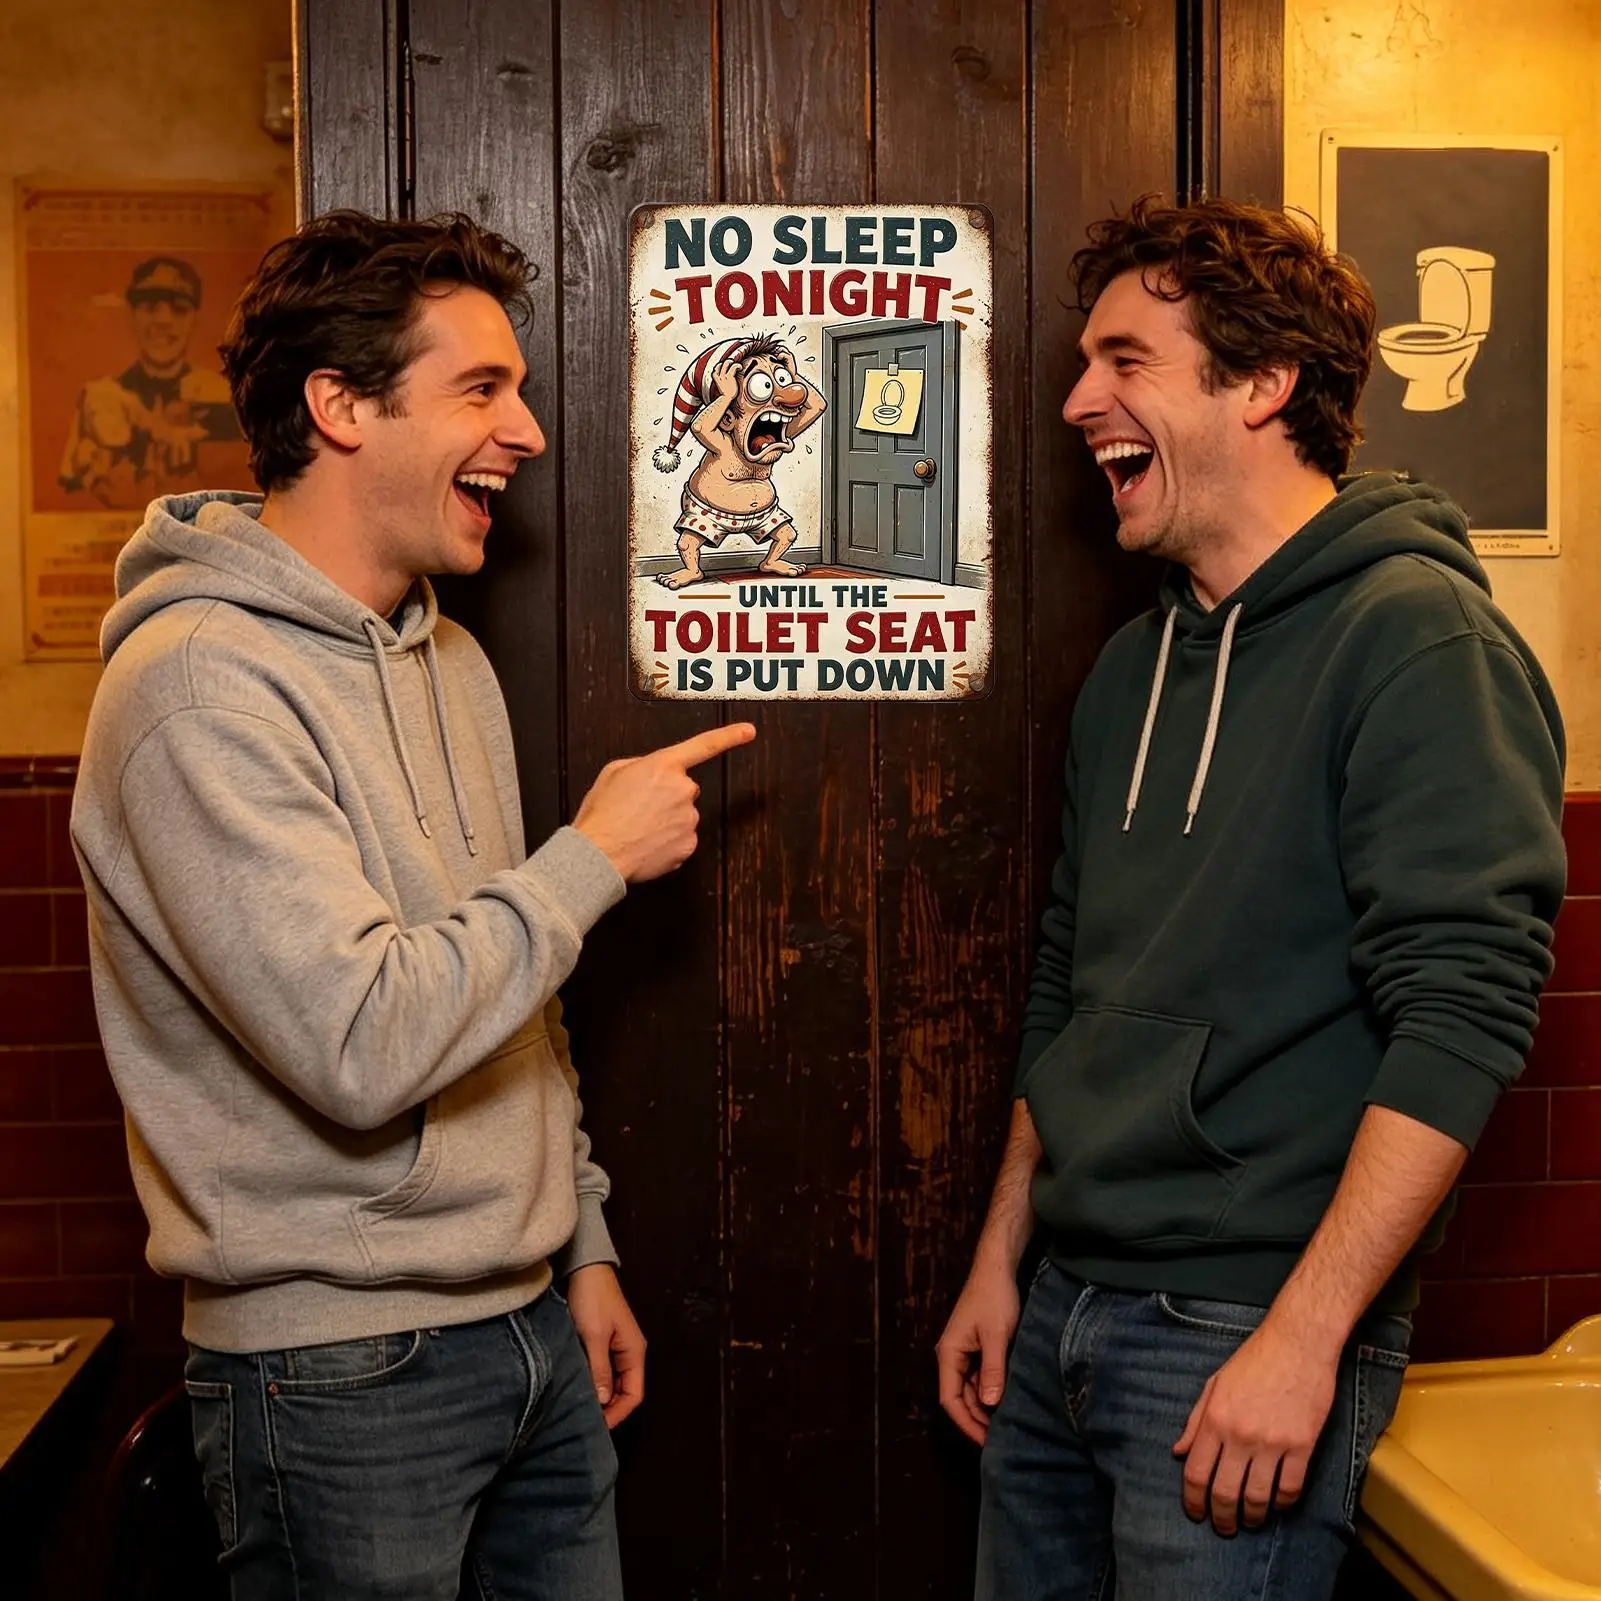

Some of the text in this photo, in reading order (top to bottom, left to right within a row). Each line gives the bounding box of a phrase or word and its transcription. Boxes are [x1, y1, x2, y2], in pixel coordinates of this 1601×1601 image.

[664, 215, 958, 269] NO SLEEP
[675, 269, 952, 324] TONIGHT
[738, 585, 888, 608] UNTIL THE
[645, 609, 976, 654] TOILET SEAT
[677, 658, 945, 691] IS PUT DOWN
